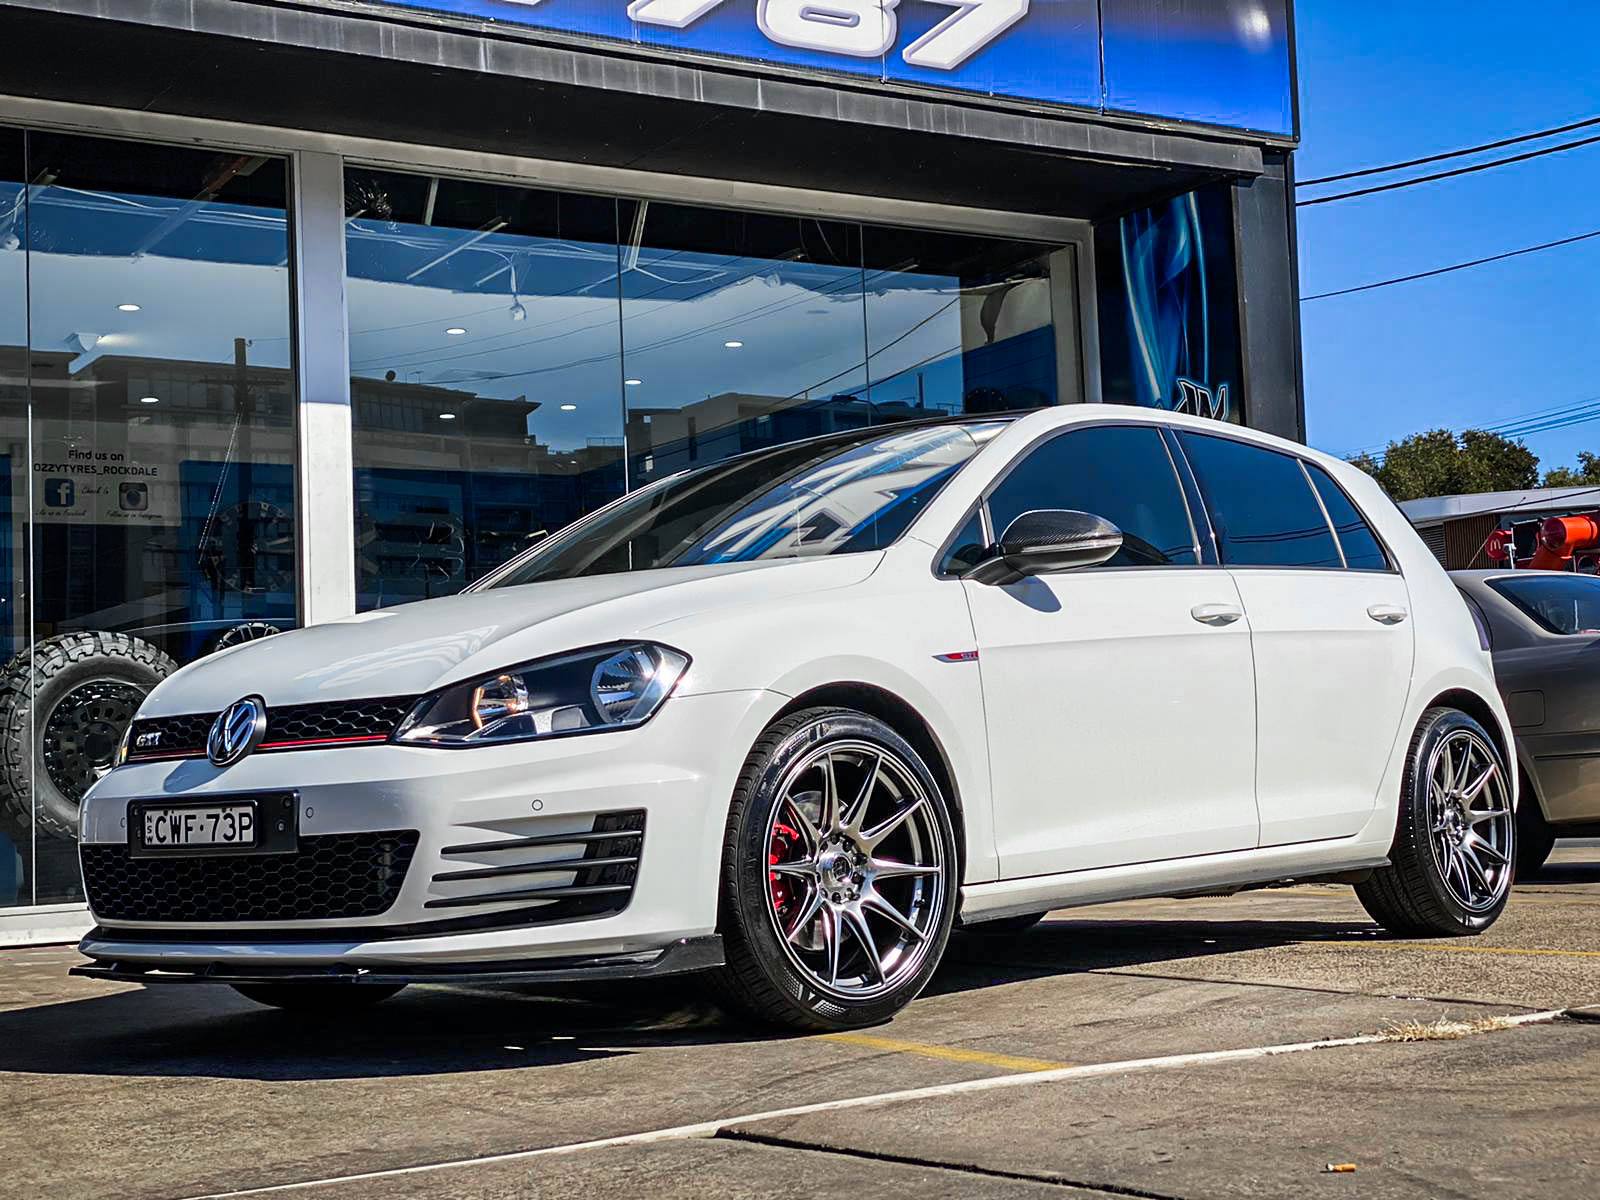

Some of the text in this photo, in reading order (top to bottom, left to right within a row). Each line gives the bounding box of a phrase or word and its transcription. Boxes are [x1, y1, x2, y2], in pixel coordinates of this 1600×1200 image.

[68, 449, 125, 461] Find us on
[33, 463, 158, 476] OZZYTYRES_ROCKDALE
